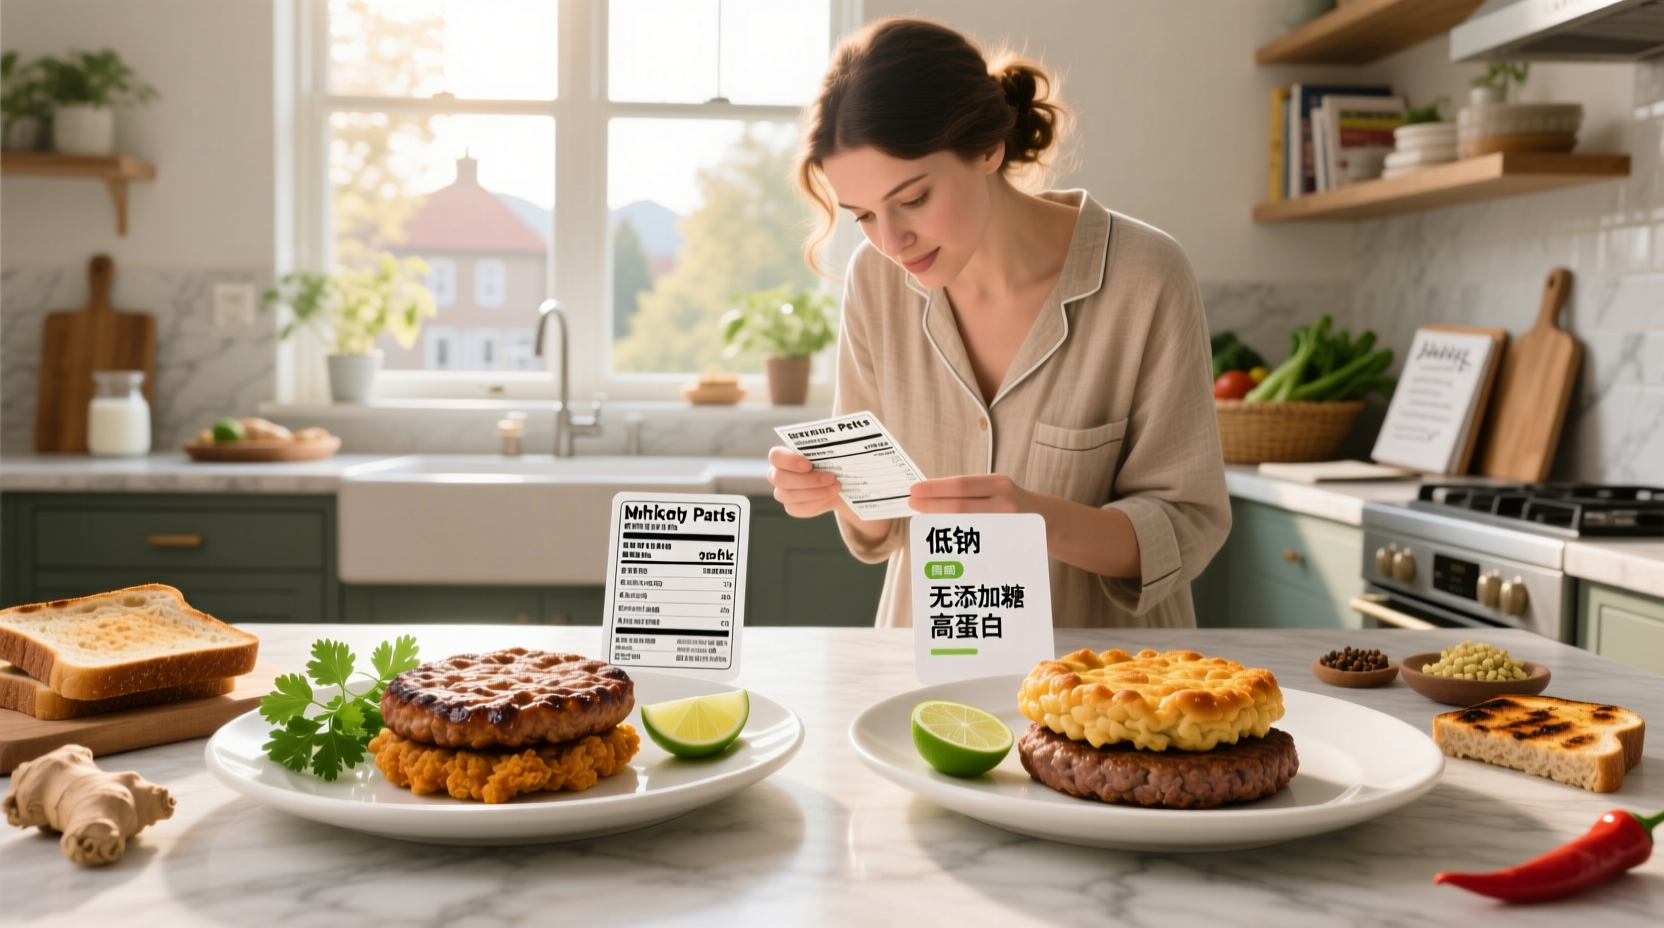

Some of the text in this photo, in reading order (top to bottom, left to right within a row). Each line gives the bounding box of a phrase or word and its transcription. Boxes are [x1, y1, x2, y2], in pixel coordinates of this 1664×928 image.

[926, 526, 981, 554] 低钠
[929, 583, 1025, 609] 无添加糖
[930, 612, 1002, 639] 高蛋白
